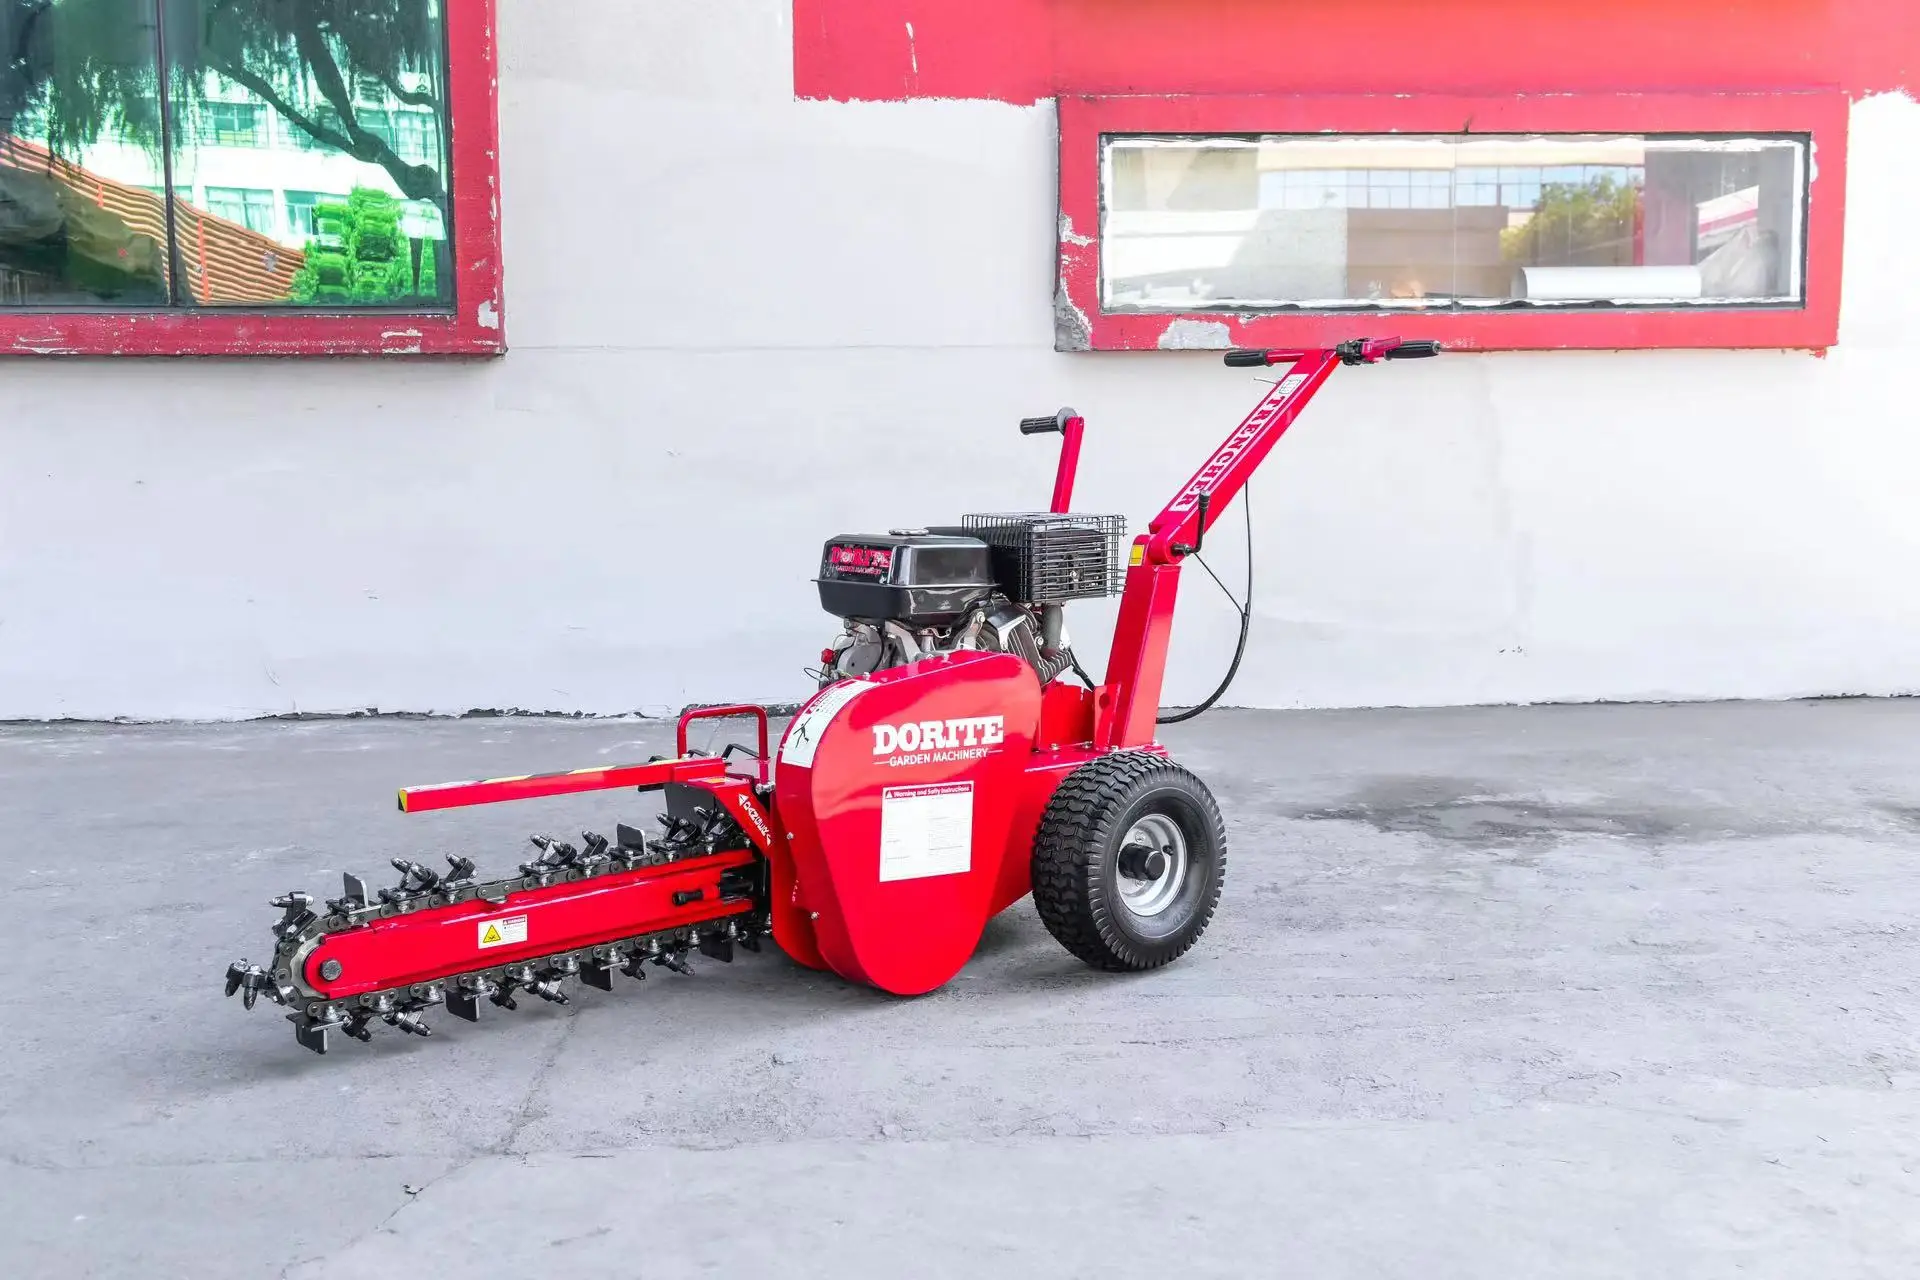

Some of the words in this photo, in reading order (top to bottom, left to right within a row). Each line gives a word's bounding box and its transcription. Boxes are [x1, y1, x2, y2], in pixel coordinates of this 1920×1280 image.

[1176, 396, 1286, 507] TRENCHER
[872, 715, 1003, 755] DORITE
[889, 753, 932, 767] GARDEN
[933, 748, 989, 763] MACHINERY
